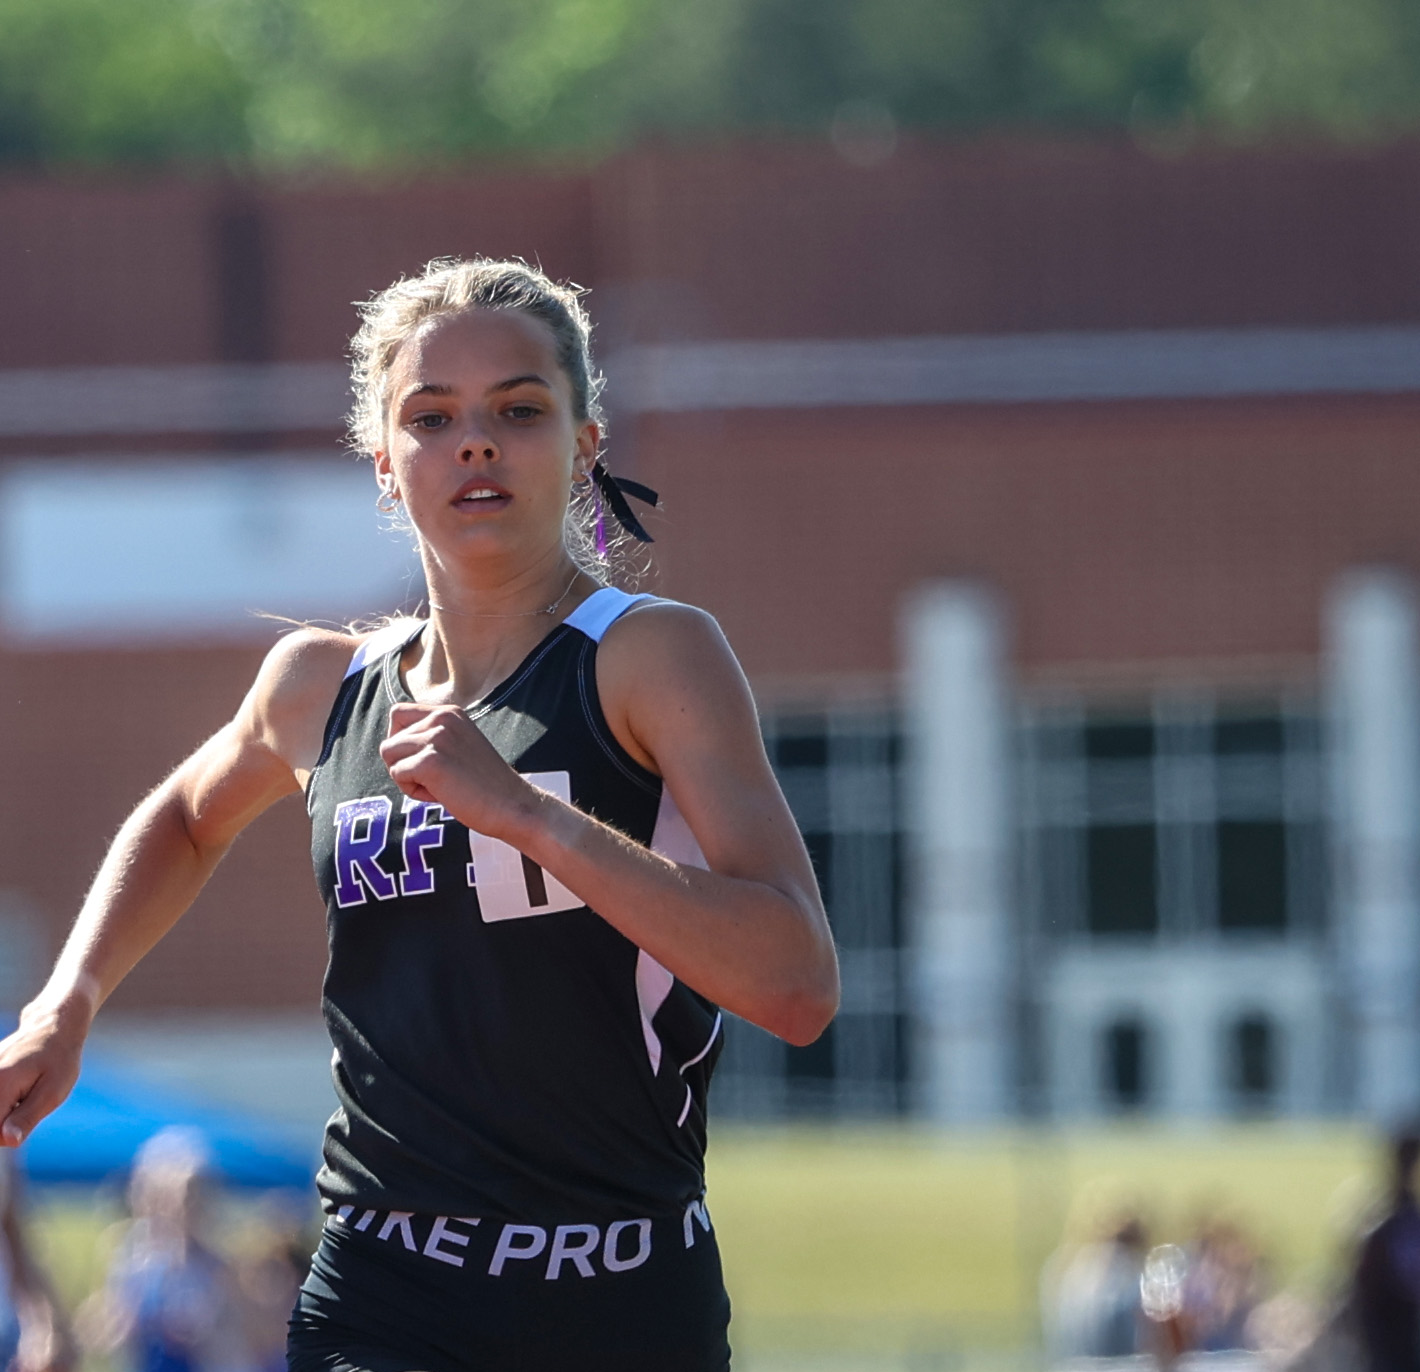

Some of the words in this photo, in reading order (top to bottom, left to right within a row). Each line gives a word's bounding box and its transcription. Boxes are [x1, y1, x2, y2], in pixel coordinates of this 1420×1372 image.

[333, 795, 477, 909] RF
[336, 1204, 482, 1267] KE
[487, 1218, 652, 1280] PRO
